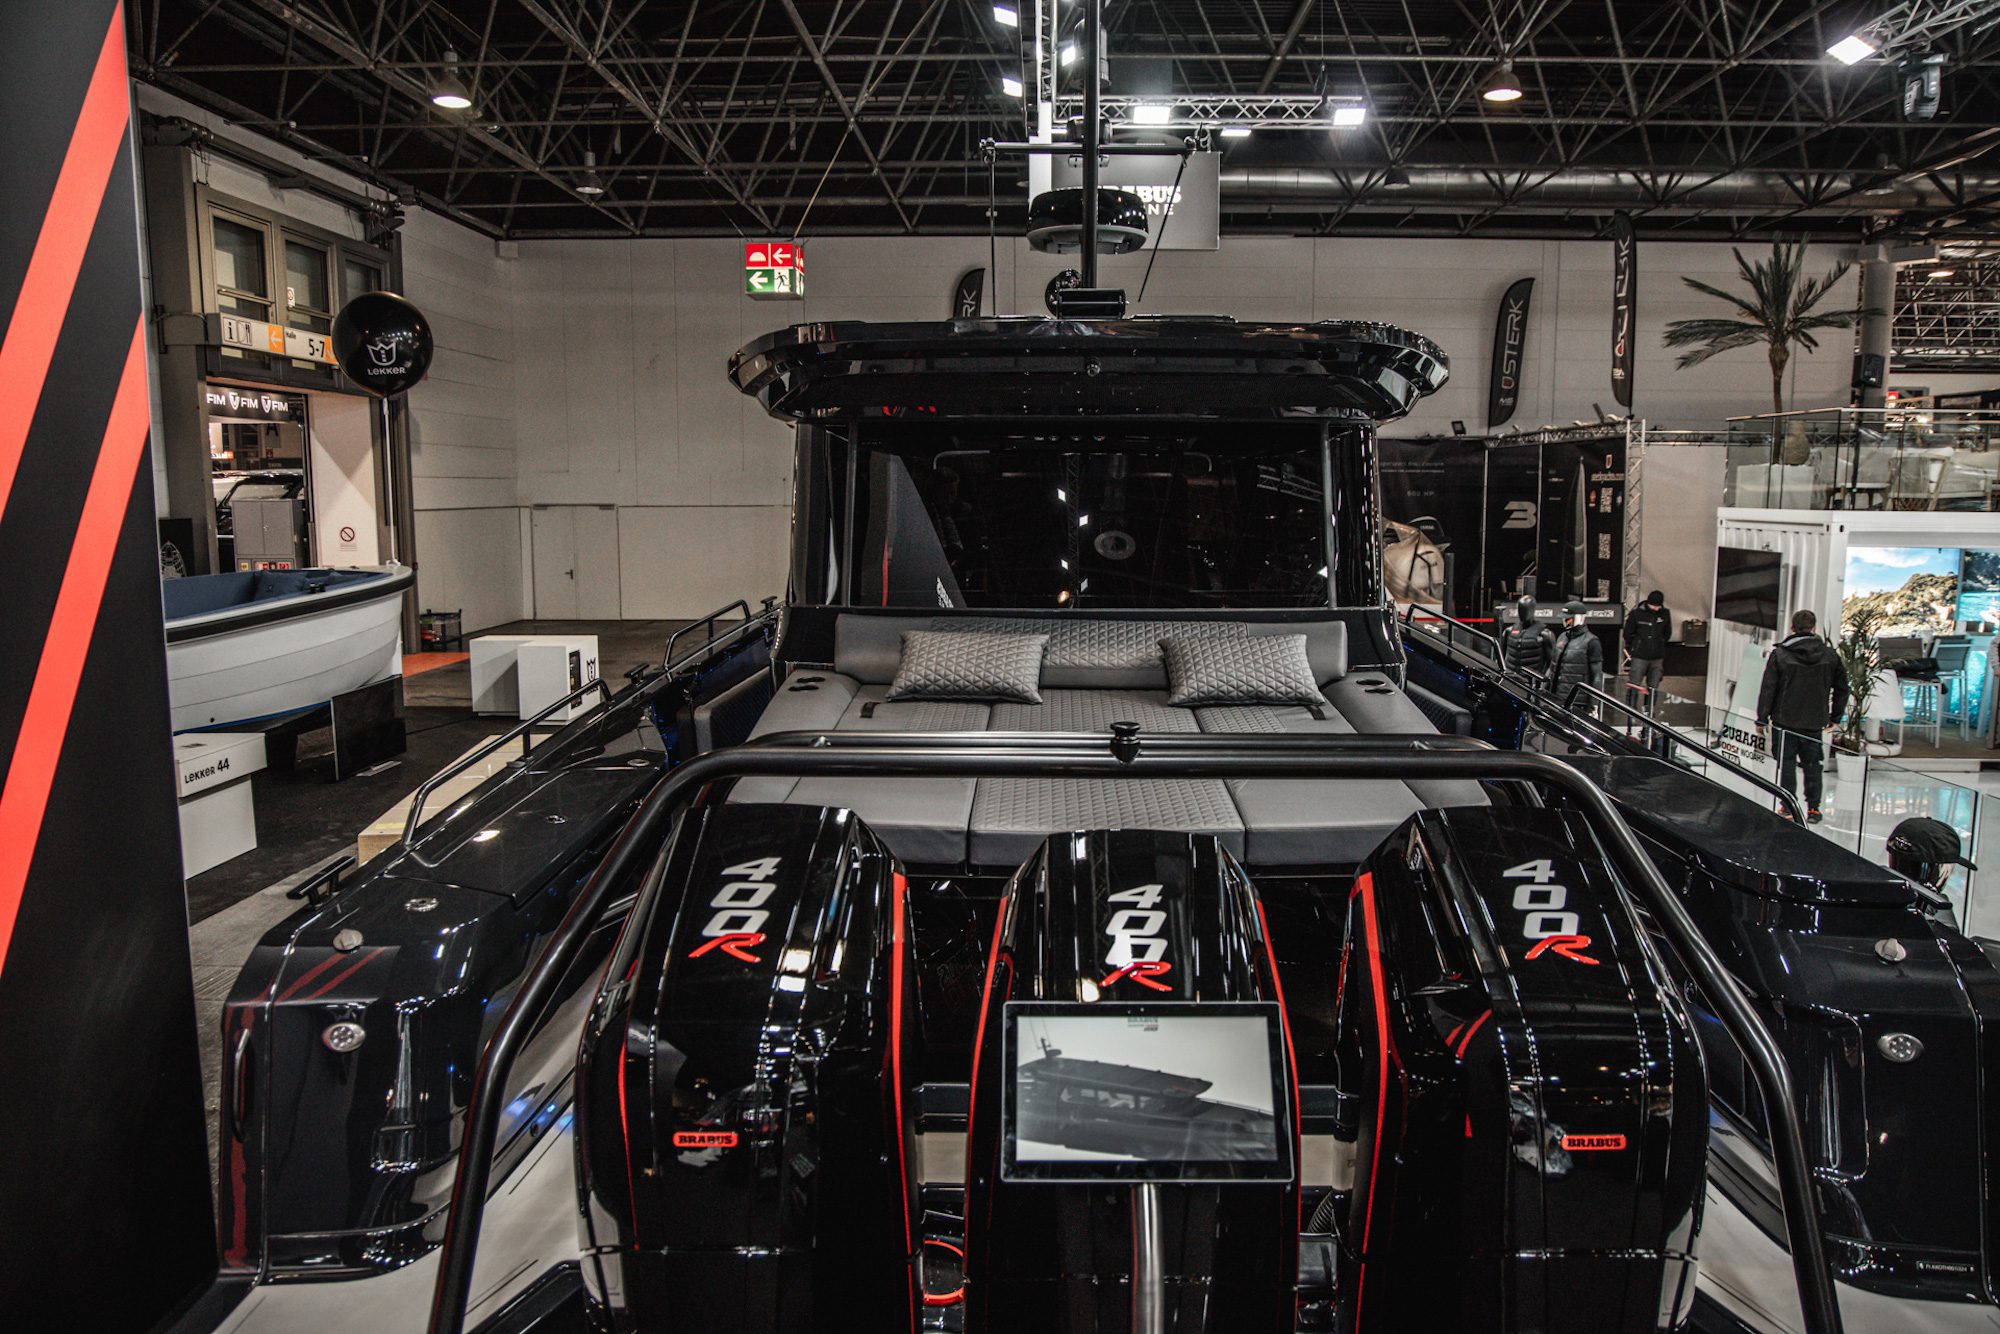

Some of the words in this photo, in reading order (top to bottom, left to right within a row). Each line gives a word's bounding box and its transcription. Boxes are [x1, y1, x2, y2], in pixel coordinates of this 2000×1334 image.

[206, 393, 226, 405] FIM
[240, 398, 258, 409] FIM
[271, 401, 288, 412] FIM
[217, 757, 230, 772] 44
[678, 1135, 732, 1144] BRABUS
[1567, 1138, 1621, 1147] BRABUS
